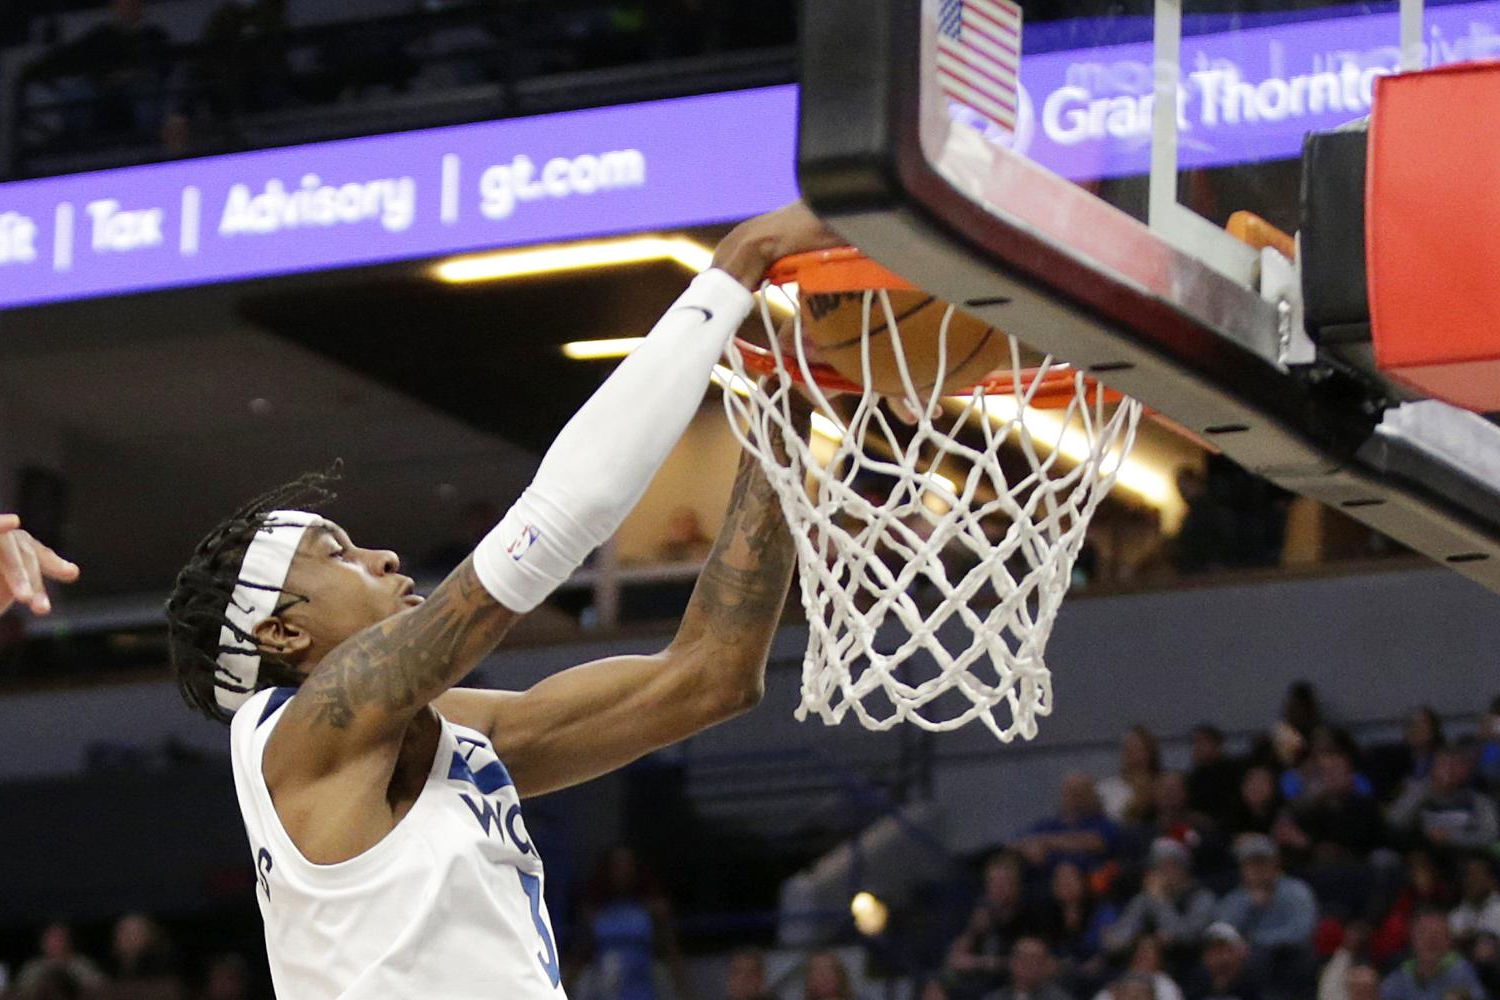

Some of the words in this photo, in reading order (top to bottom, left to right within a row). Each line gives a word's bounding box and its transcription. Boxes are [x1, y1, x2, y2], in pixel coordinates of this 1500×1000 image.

[86, 198, 164, 253] Tax
[218, 172, 417, 233] Advisory
[479, 148, 646, 221] gt.com
[458, 793, 539, 858] WO
